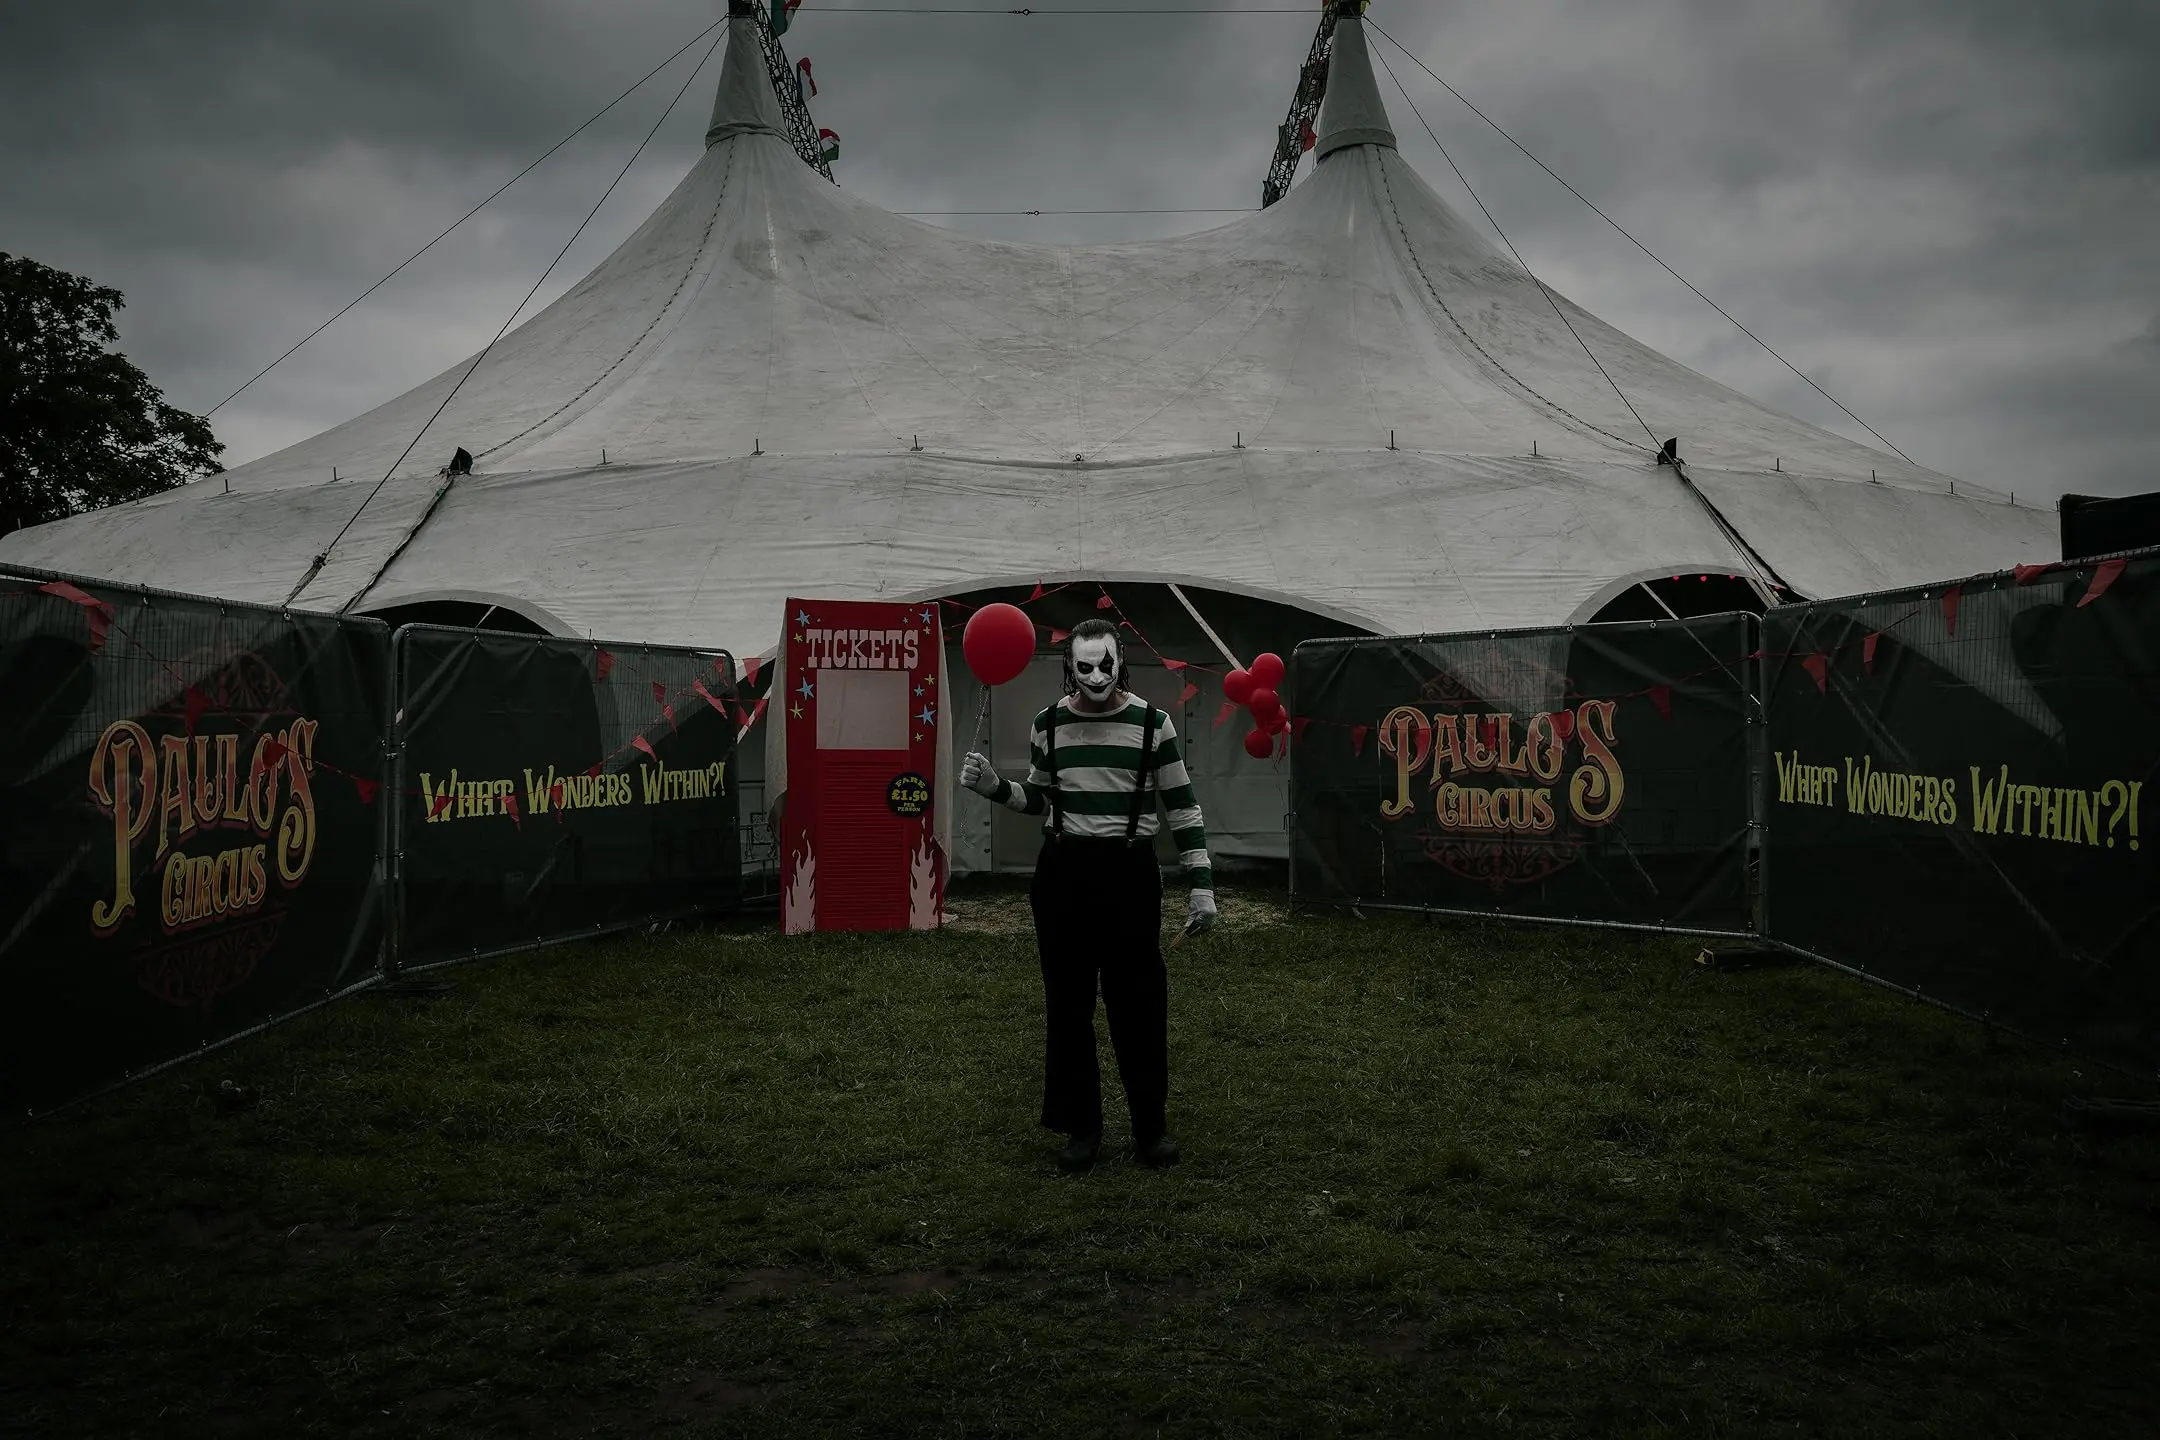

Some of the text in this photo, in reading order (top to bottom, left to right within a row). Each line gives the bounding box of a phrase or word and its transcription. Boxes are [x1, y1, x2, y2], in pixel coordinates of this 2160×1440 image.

[806, 628, 919, 670] TICKETS
[419, 759, 727, 824] WHAT WONDERS WITHIN?!
[891, 789, 929, 802] £1.50
[1435, 781, 1556, 830] CIRCUS
[1774, 749, 2143, 852] WHAT WONDERS WITHIN?!
[161, 843, 267, 928] CIRCUS
